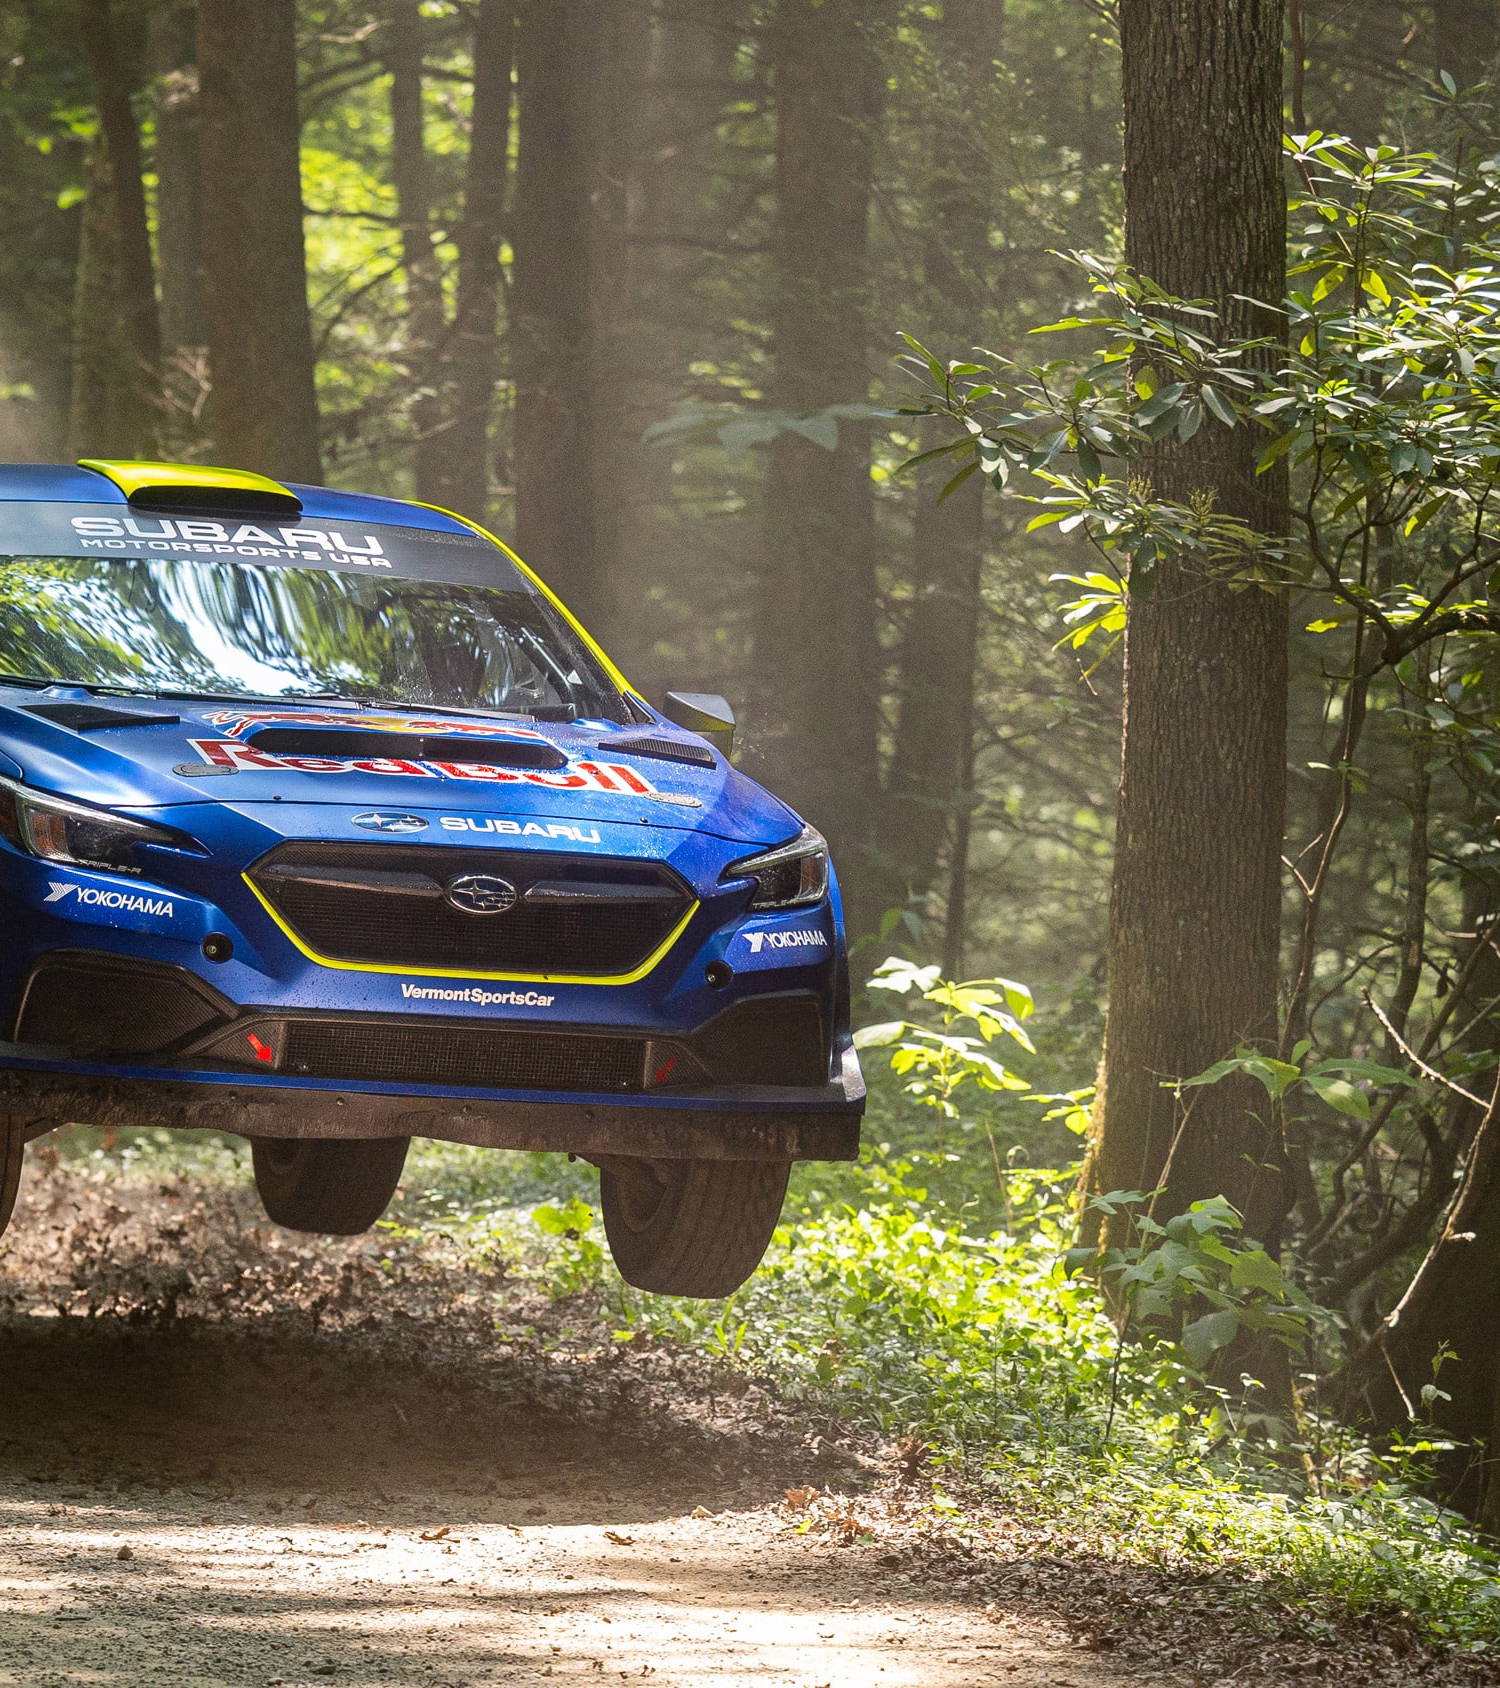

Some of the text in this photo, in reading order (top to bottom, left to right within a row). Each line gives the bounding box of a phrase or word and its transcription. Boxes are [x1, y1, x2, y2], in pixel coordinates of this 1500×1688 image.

[70, 516, 384, 556] SUBARU
[81, 538, 393, 569] MOTORSPORTS USA
[441, 816, 601, 844] SUBARU
[77, 886, 174, 918] YOKOHAMA
[764, 929, 828, 949] YOKOHAMA
[401, 983, 555, 1007] VermontSportsCar
